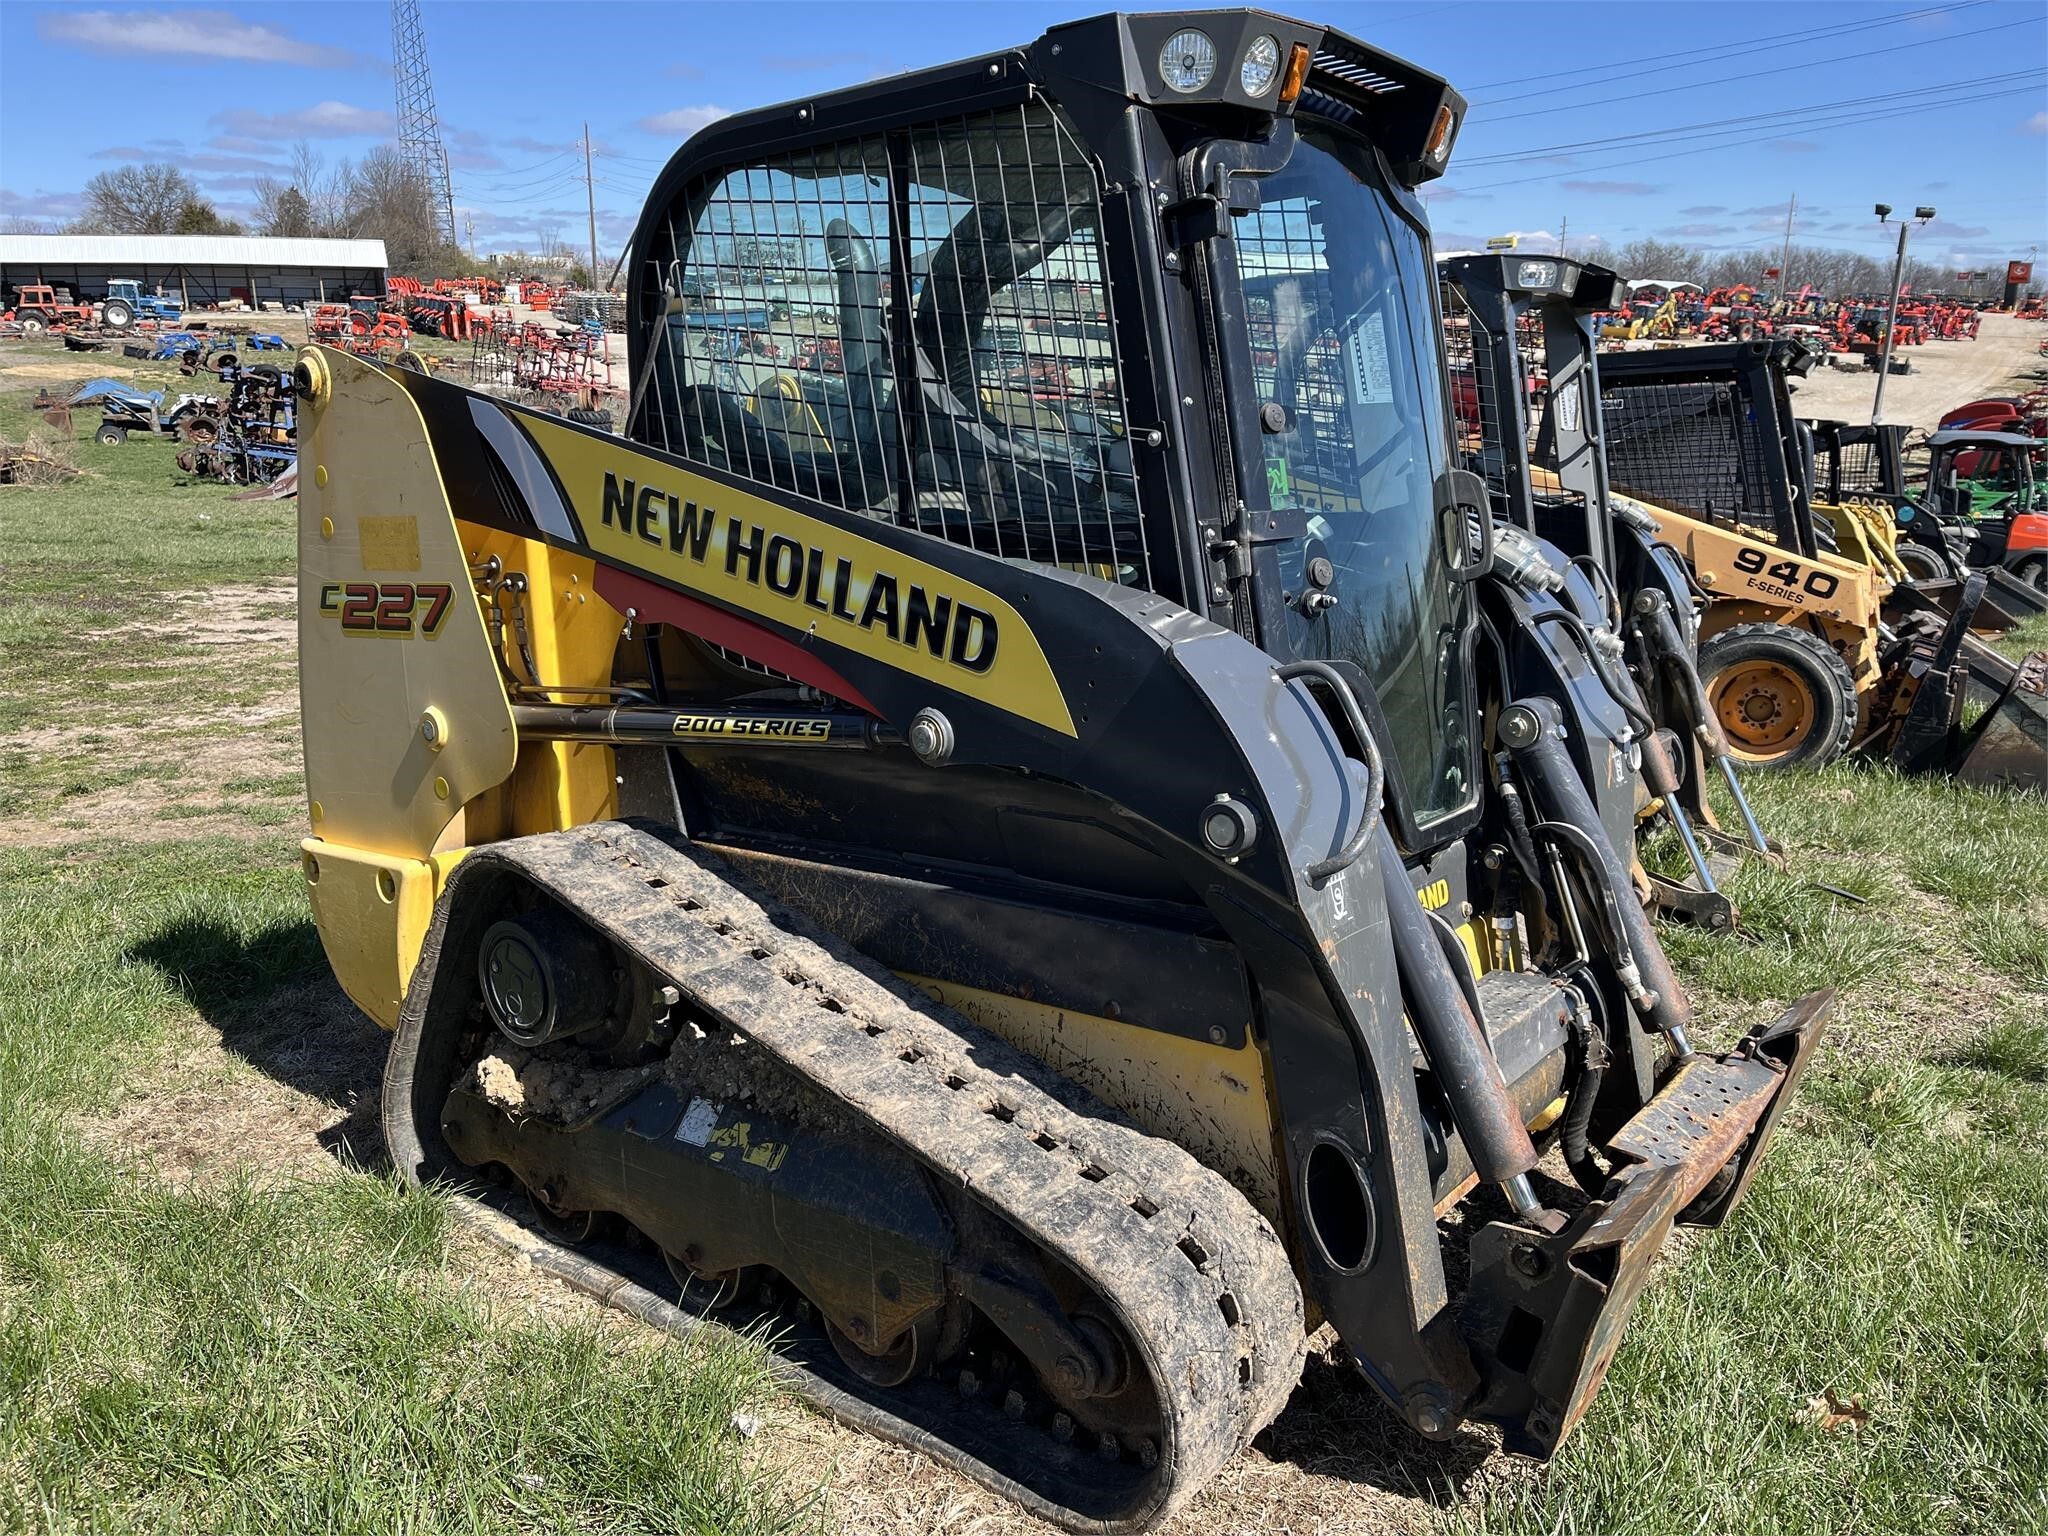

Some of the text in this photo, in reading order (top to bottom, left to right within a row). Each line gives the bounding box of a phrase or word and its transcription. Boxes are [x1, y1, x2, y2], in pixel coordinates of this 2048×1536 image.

[600, 470, 1000, 675] NEW HOLLAND
[1733, 548, 1839, 599] 940
[1746, 577, 1805, 604] E-SERIES
[320, 583, 454, 635] C227
[675, 717, 830, 737] 200 SERIES
